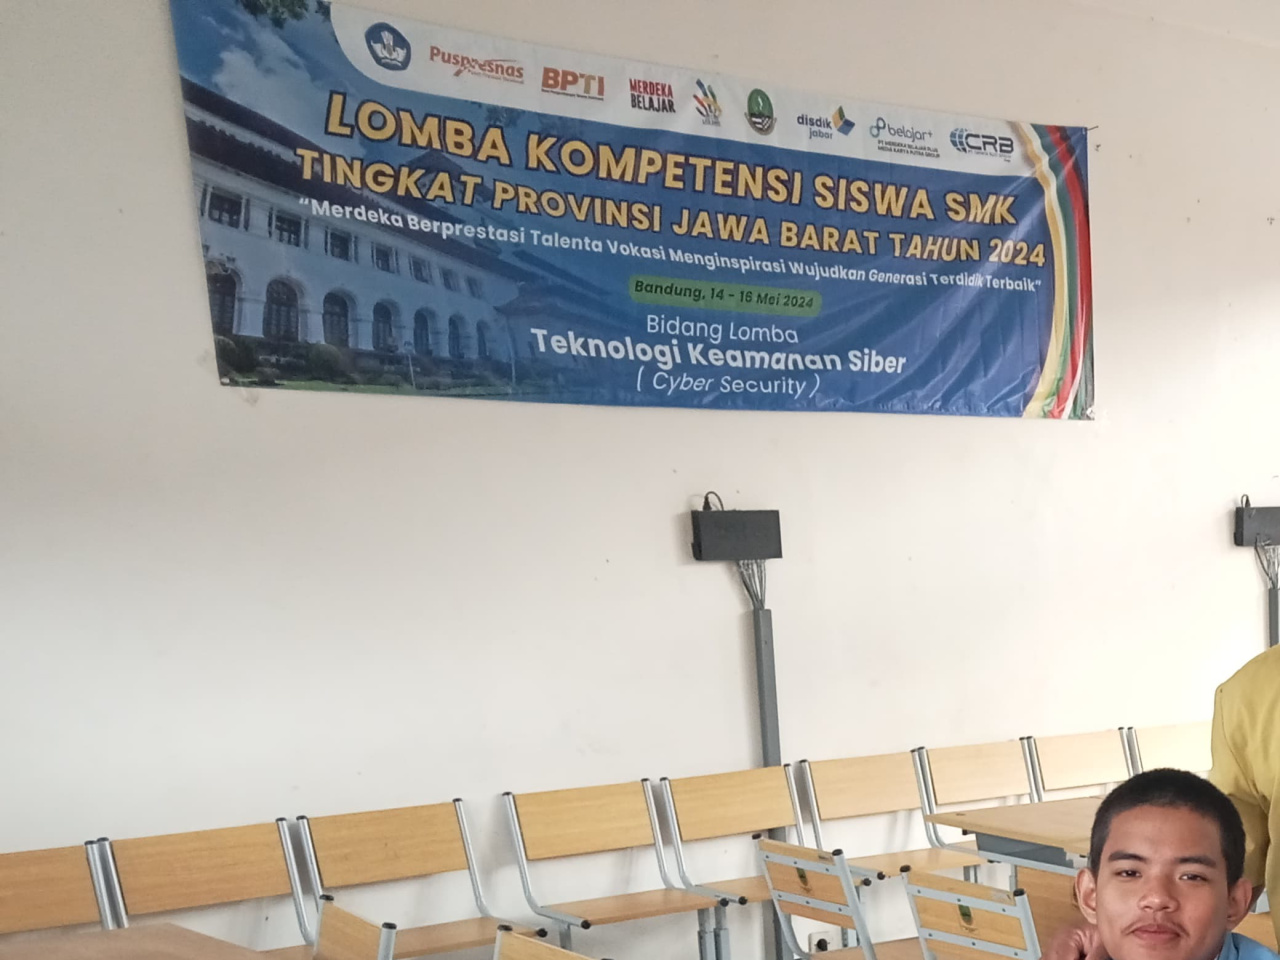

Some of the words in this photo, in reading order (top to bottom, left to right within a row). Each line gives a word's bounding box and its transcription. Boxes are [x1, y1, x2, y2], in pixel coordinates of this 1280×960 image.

[429, 45, 524, 79] Puspresnas
[542, 67, 605, 96] BPTI
[629, 78, 673, 99] MERDEKA
[631, 94, 676, 113] BELAJAR
[797, 114, 832, 129] disdik
[809, 127, 833, 140] jabar
[325, 90, 513, 167] LOMBA
[527, 132, 802, 204] KOMPETENSI
[814, 173, 935, 220] SISWA
[945, 191, 1018, 226] SMK
[965, 133, 1014, 154] CRB
[296, 147, 482, 206] TINGKAT
[493, 180, 662, 233] PROVINSI
[672, 208, 770, 245] JAWA
[780, 221, 880, 256] BARAT
[889, 231, 980, 263] TAHUN
[987, 238, 1046, 268] 2024
[407, 213, 526, 245] Berprestasi
[530, 230, 603, 253] Talenta
[607, 239, 666, 261] Vokasi
[669, 246, 786, 275] Menginspirasi
[791, 261, 866, 282] Wujudkan
[868, 267, 928, 287] Generasi
[930, 272, 984, 288] Terdidik
[634, 280, 706, 302] Bandung,
[710, 287, 725, 301] 14
[739, 290, 753, 303] 16
[756, 291, 782, 307] Mei
[784, 294, 815, 309] 2024
[646, 314, 722, 345] Bidang
[729, 321, 799, 344] Lomba
[531, 327, 682, 371] Teknologi
[687, 342, 842, 371] Keamanan
[848, 346, 907, 375] Siber
[652, 371, 714, 396] Cyber
[720, 375, 806, 400] Security
